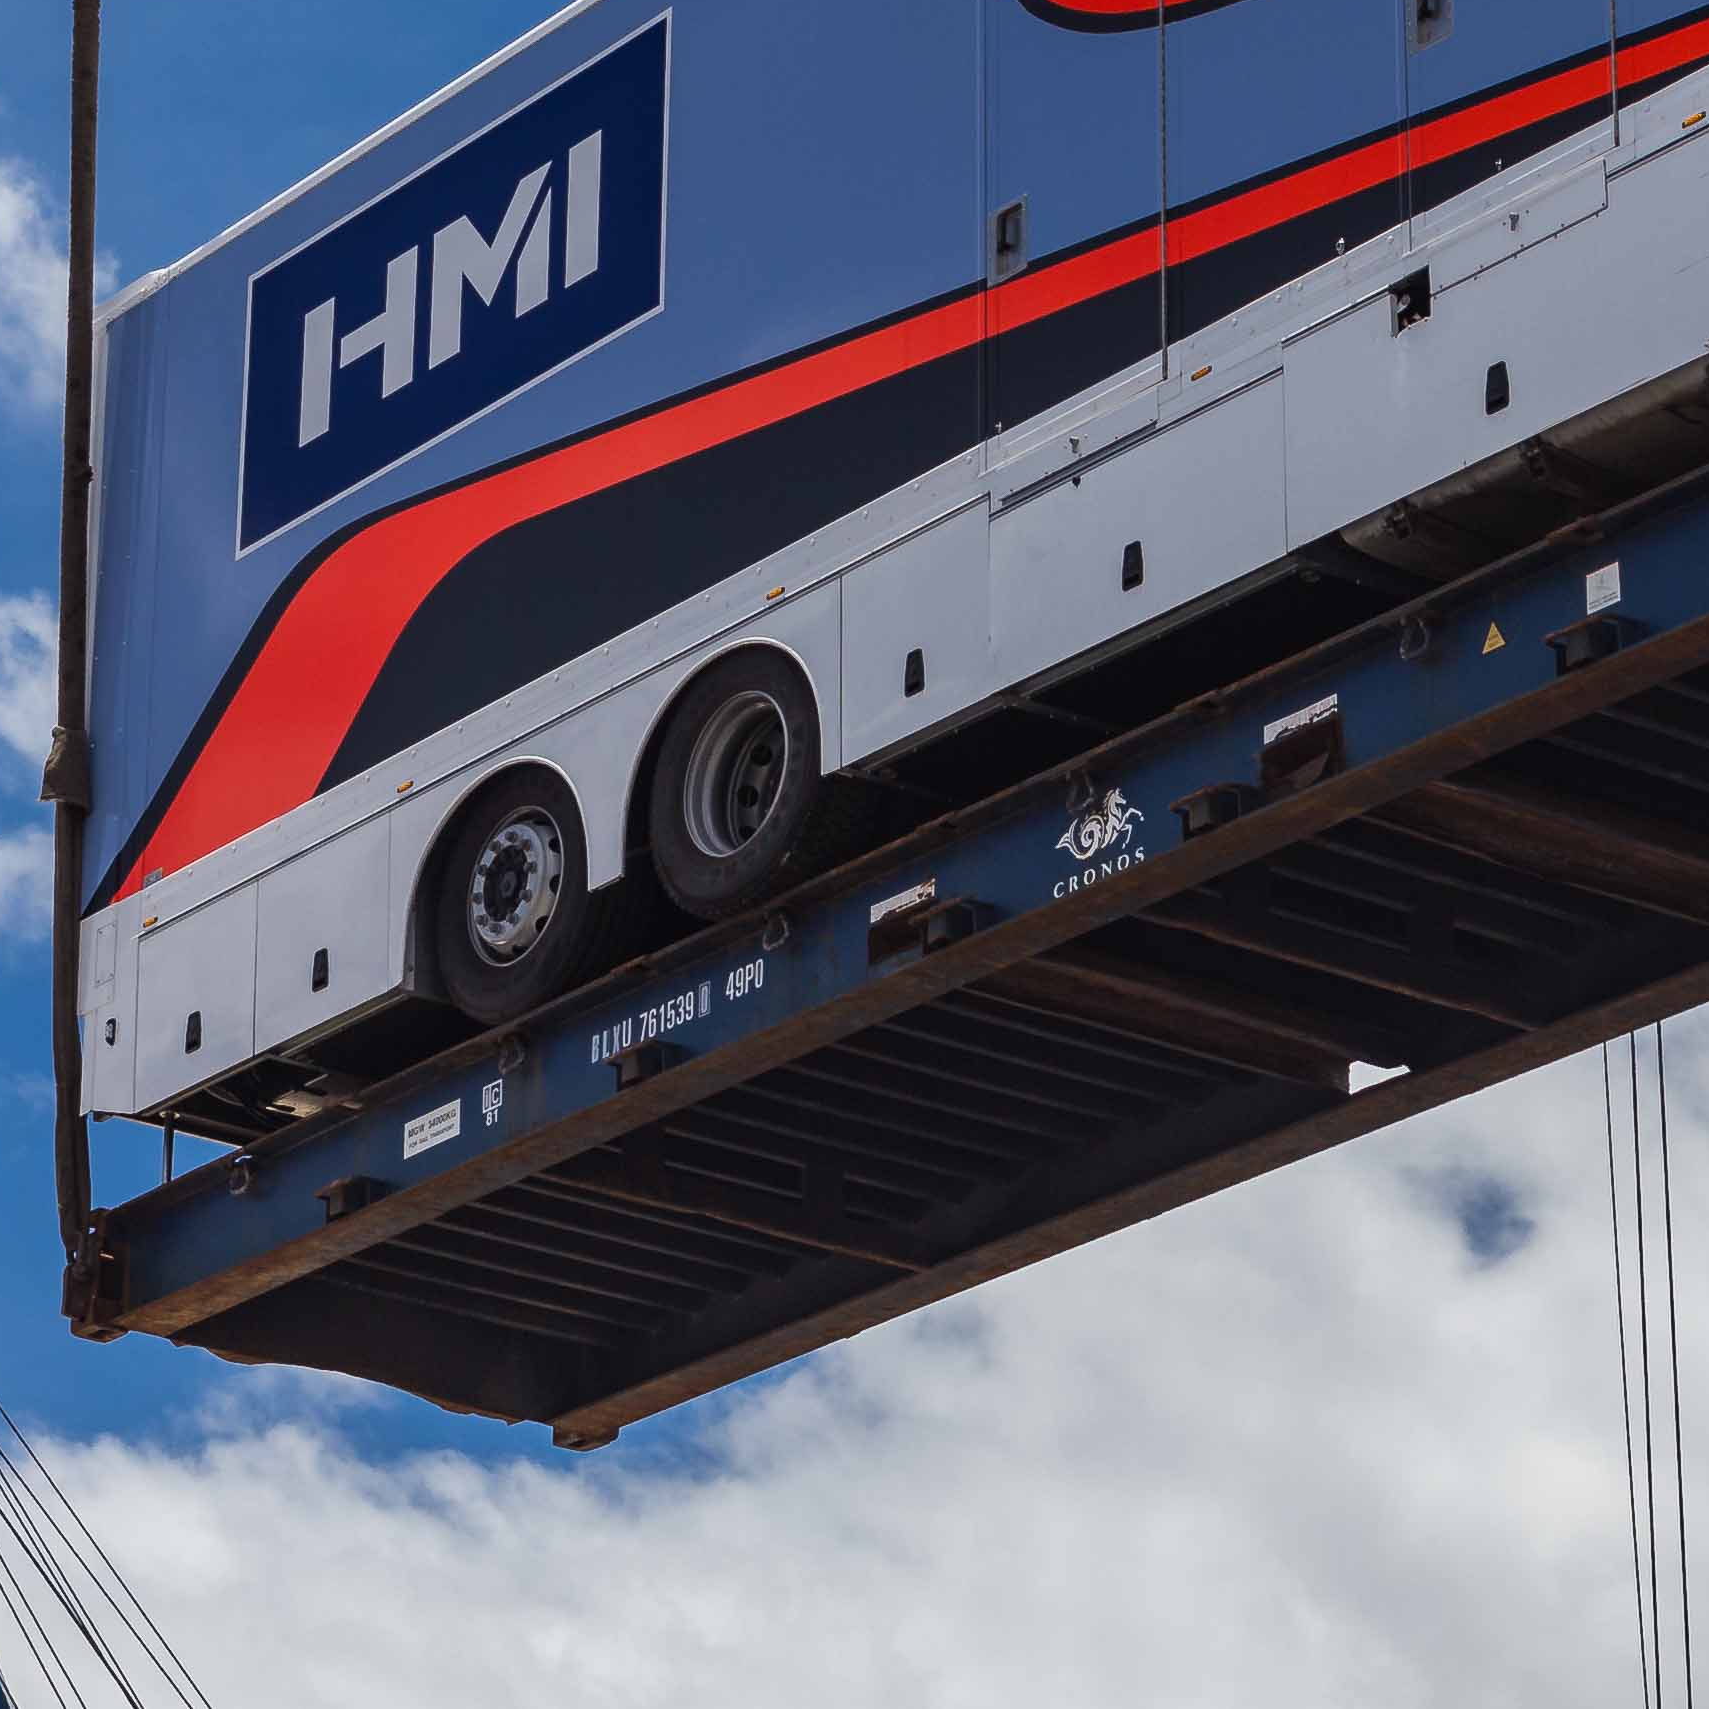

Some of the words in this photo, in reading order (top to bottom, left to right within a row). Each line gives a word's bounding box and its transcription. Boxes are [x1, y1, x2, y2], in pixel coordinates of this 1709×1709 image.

[298, 129, 602, 448] HMI
[1053, 846, 1145, 899] CRONOS
[639, 991, 694, 1043] 761539
[725, 958, 764, 1001] 49P0
